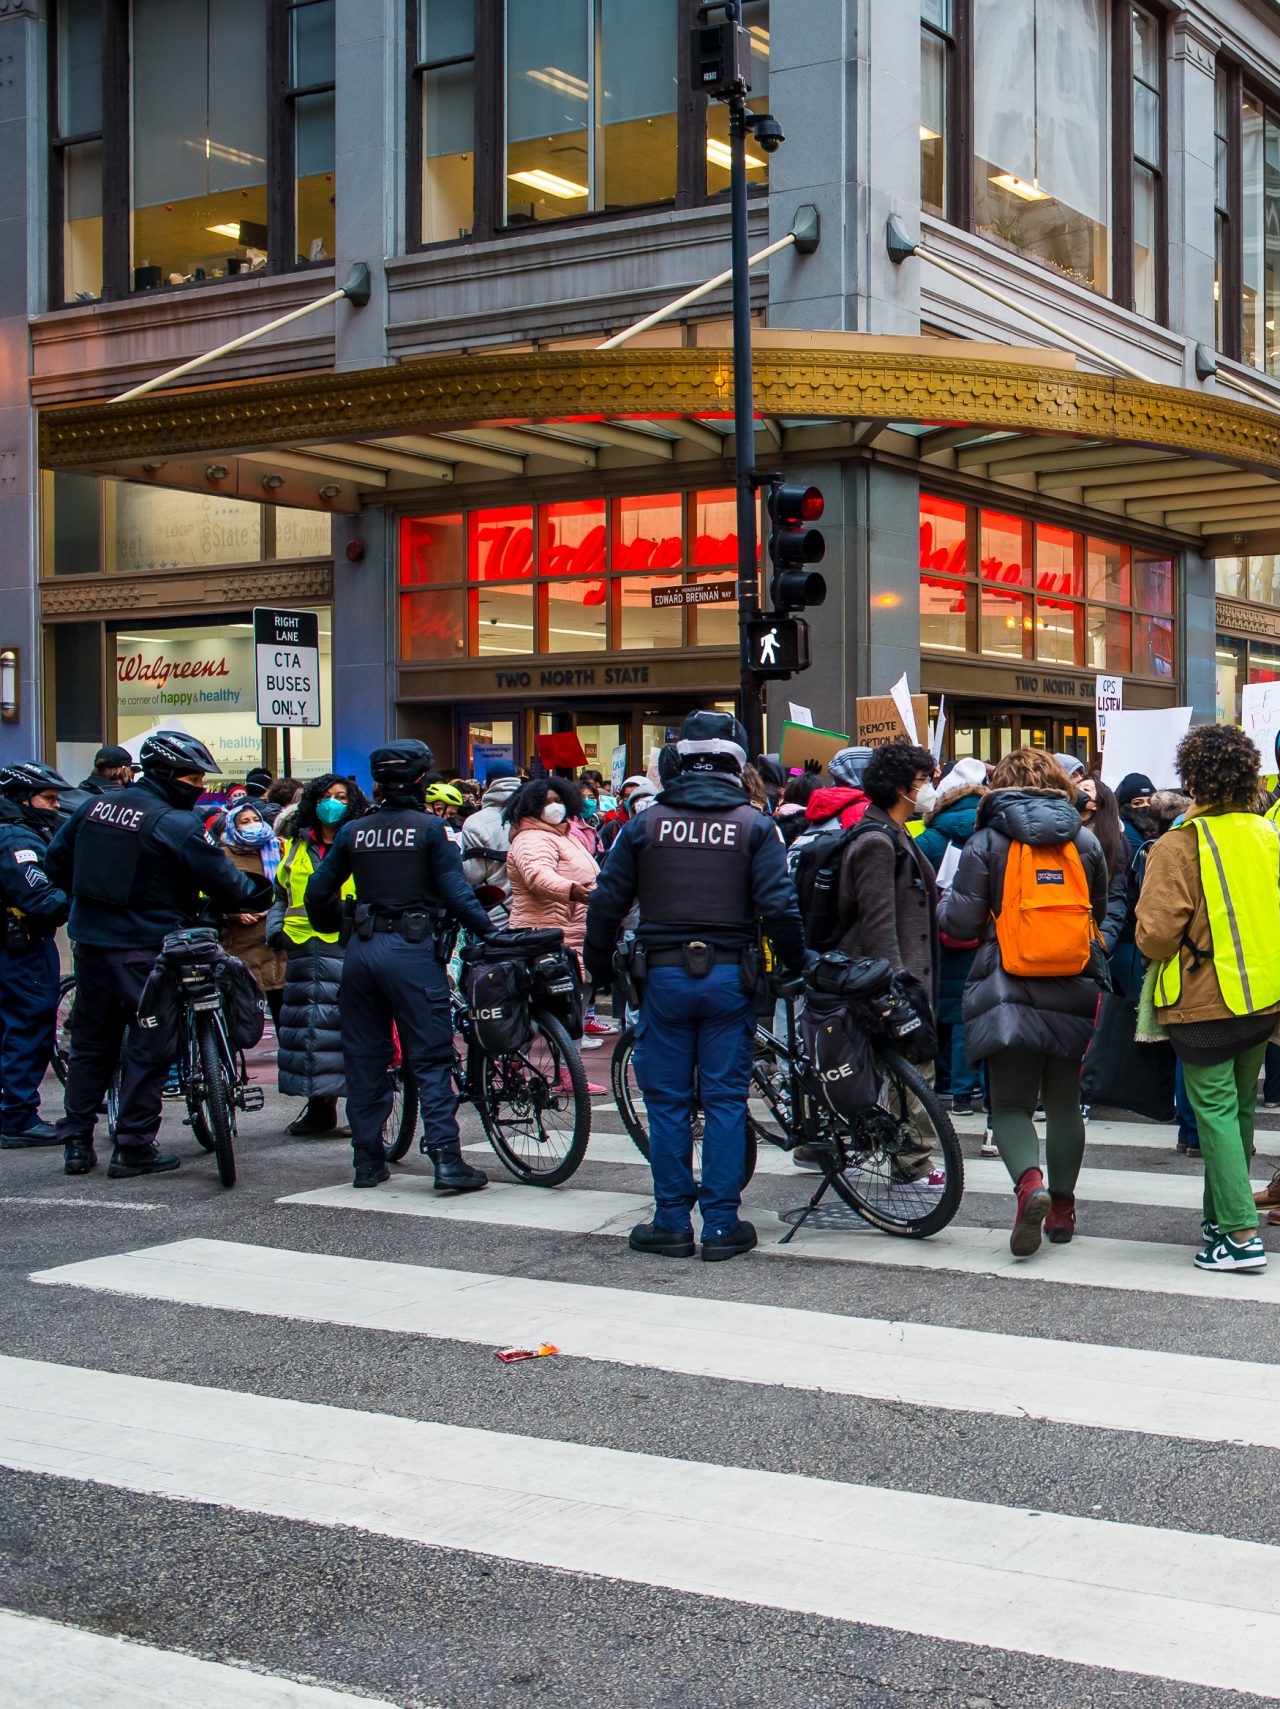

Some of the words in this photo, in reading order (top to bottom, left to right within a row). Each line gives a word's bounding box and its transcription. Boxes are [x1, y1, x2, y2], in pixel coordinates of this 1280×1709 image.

[253, 520, 299, 547] Seet
[654, 593, 684, 605] EDWARD
[685, 590, 719, 603] BRENNAN
[721, 590, 732, 598] WAY
[274, 616, 299, 628] RIGHT
[276, 630, 299, 641] LANE
[274, 652, 301, 668] CTA
[117, 653, 230, 689] Walgreens
[496, 671, 532, 688] TWO
[540, 668, 595, 687] NORTH
[605, 666, 649, 684] STATE
[266, 675, 311, 692] BUSES
[1016, 675, 1039, 692] TWO
[1043, 678, 1076, 695] NORTH
[1080, 682, 1096, 698] STA
[1103, 680, 1116, 694] CPS
[127, 695, 151, 706] corner
[151, 694, 159, 704] of
[160, 691, 193, 706] happy
[199, 688, 240, 704] healthy
[1098, 696, 1121, 711] LISTEN
[272, 699, 307, 716] ONLY
[1098, 714, 1106, 727] TO
[859, 721, 897, 736] REMOTE
[168, 736, 186, 750] POLICE
[219, 735, 262, 750] healthy
[860, 735, 891, 747] OPTION
[90, 801, 144, 828] POLICE
[354, 828, 417, 849] POLICE
[659, 820, 737, 845] POLICE
[470, 1007, 503, 1020] LICE
